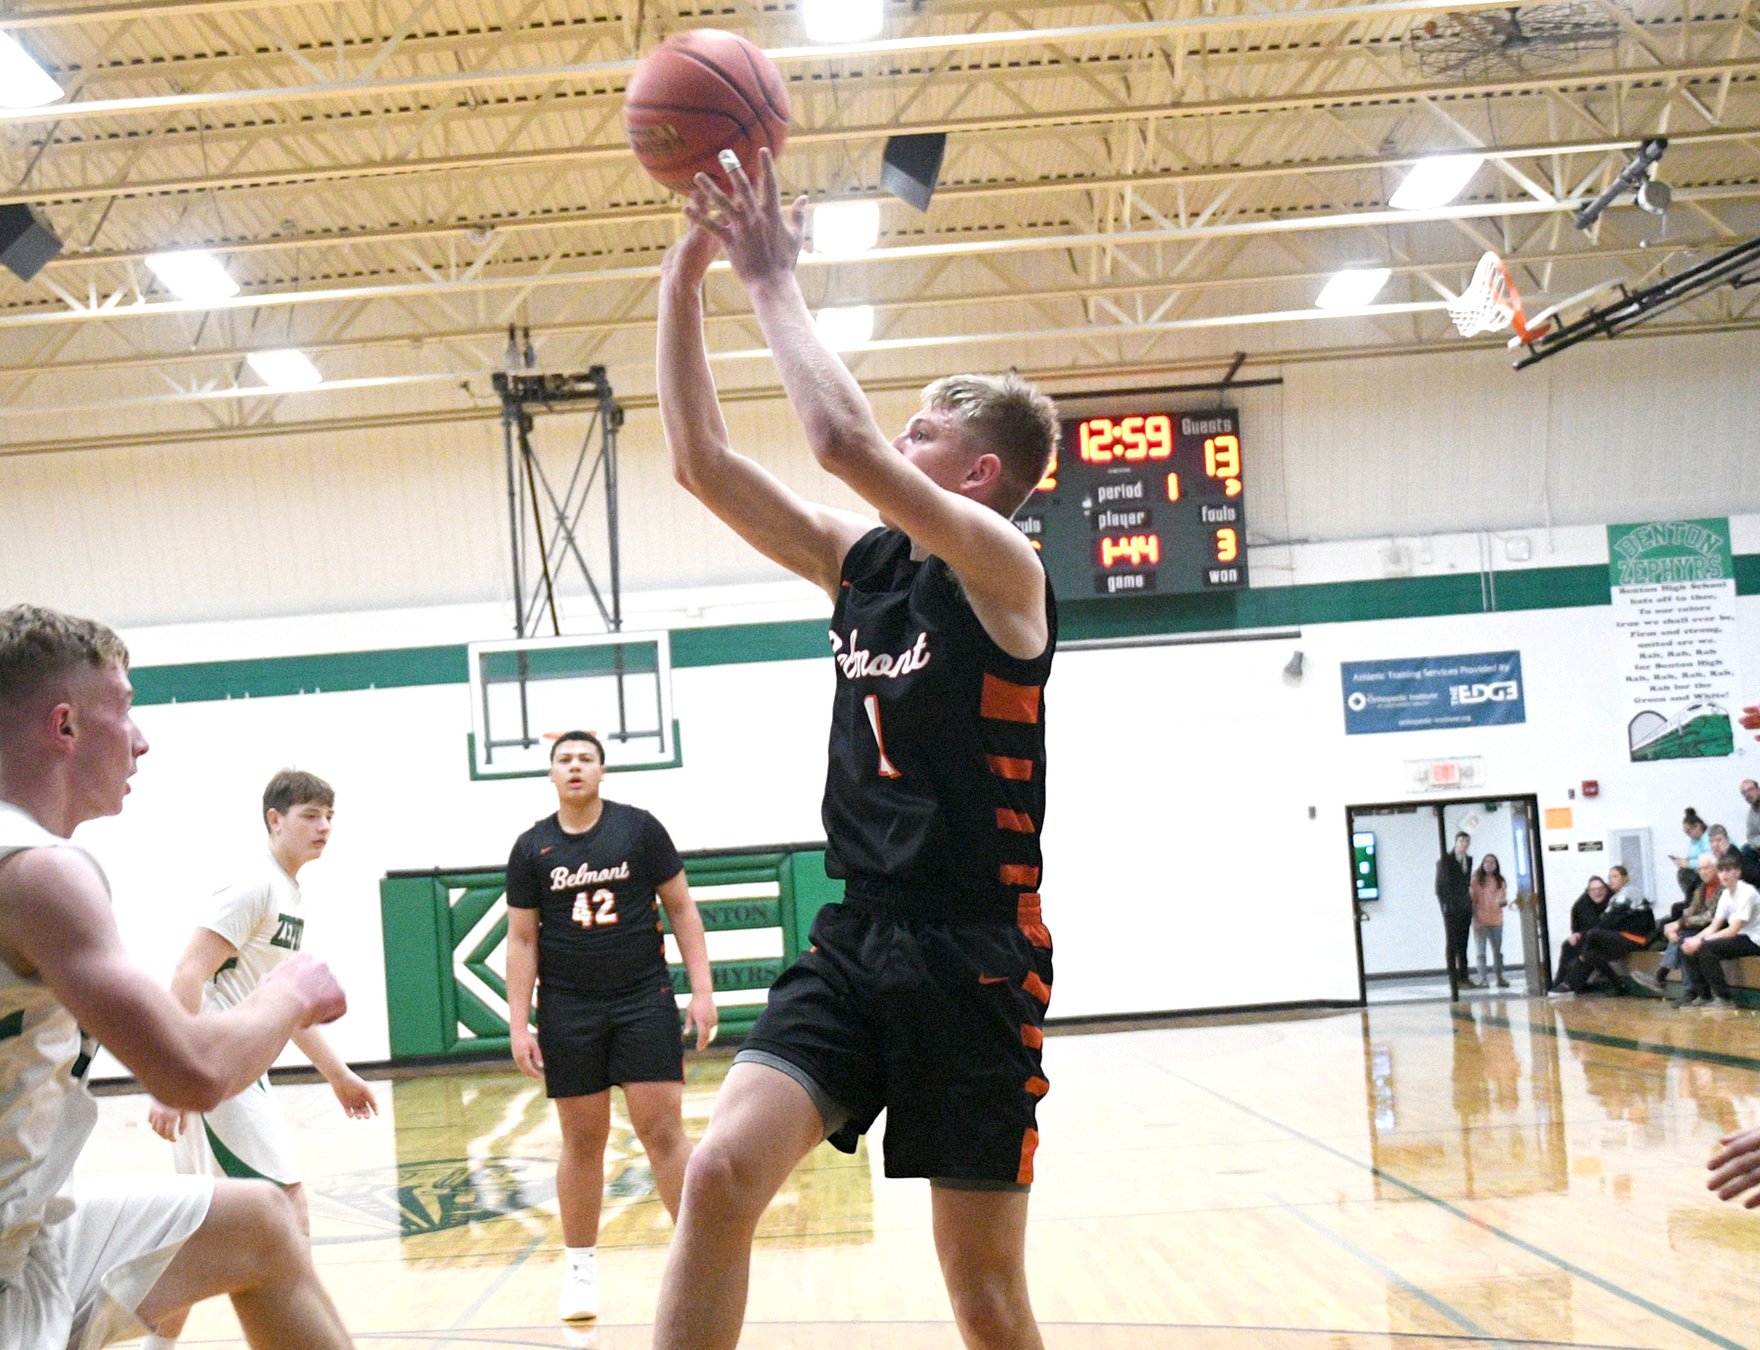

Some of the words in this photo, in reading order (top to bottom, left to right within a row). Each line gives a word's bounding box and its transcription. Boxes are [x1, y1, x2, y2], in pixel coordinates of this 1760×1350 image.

[1181, 417, 1233, 436] Guests
[1079, 415, 1172, 463] 12:59
[1204, 435, 1241, 478] 13
[1098, 481, 1143, 503] period
[1167, 472, 1180, 502] 1
[1098, 510, 1145, 530] player
[1201, 504, 1236, 523] fouls
[1014, 516, 1041, 533] uls
[1216, 528, 1237, 562] 3
[1612, 521, 1724, 560] BENTON
[1208, 568, 1238, 584] won
[1617, 553, 1723, 586] ZEPHYRS
[1107, 574, 1144, 593] game
[1619, 587, 1657, 595] Benton
[1661, 584, 1686, 593] High
[1690, 581, 1727, 590] School
[1657, 595, 1672, 603] off
[1677, 605, 1711, 613] colors
[1663, 617, 1688, 625] shall
[1630, 631, 1657, 639] Firm
[1660, 628, 1680, 636] and
[1352, 671, 1386, 682] Athletic
[1387, 669, 1422, 680] Training
[1422, 668, 1458, 678] Services
[1459, 664, 1498, 675] Provided
[1655, 662, 1694, 670] Benton
[1697, 659, 1723, 668] High
[1458, 680, 1519, 704] EDGE
[1670, 694, 1690, 702] and
[863, 694, 902, 779] 1
[550, 861, 630, 891] Belmont
[572, 888, 619, 929] 42
[700, 902, 769, 924] NTON
